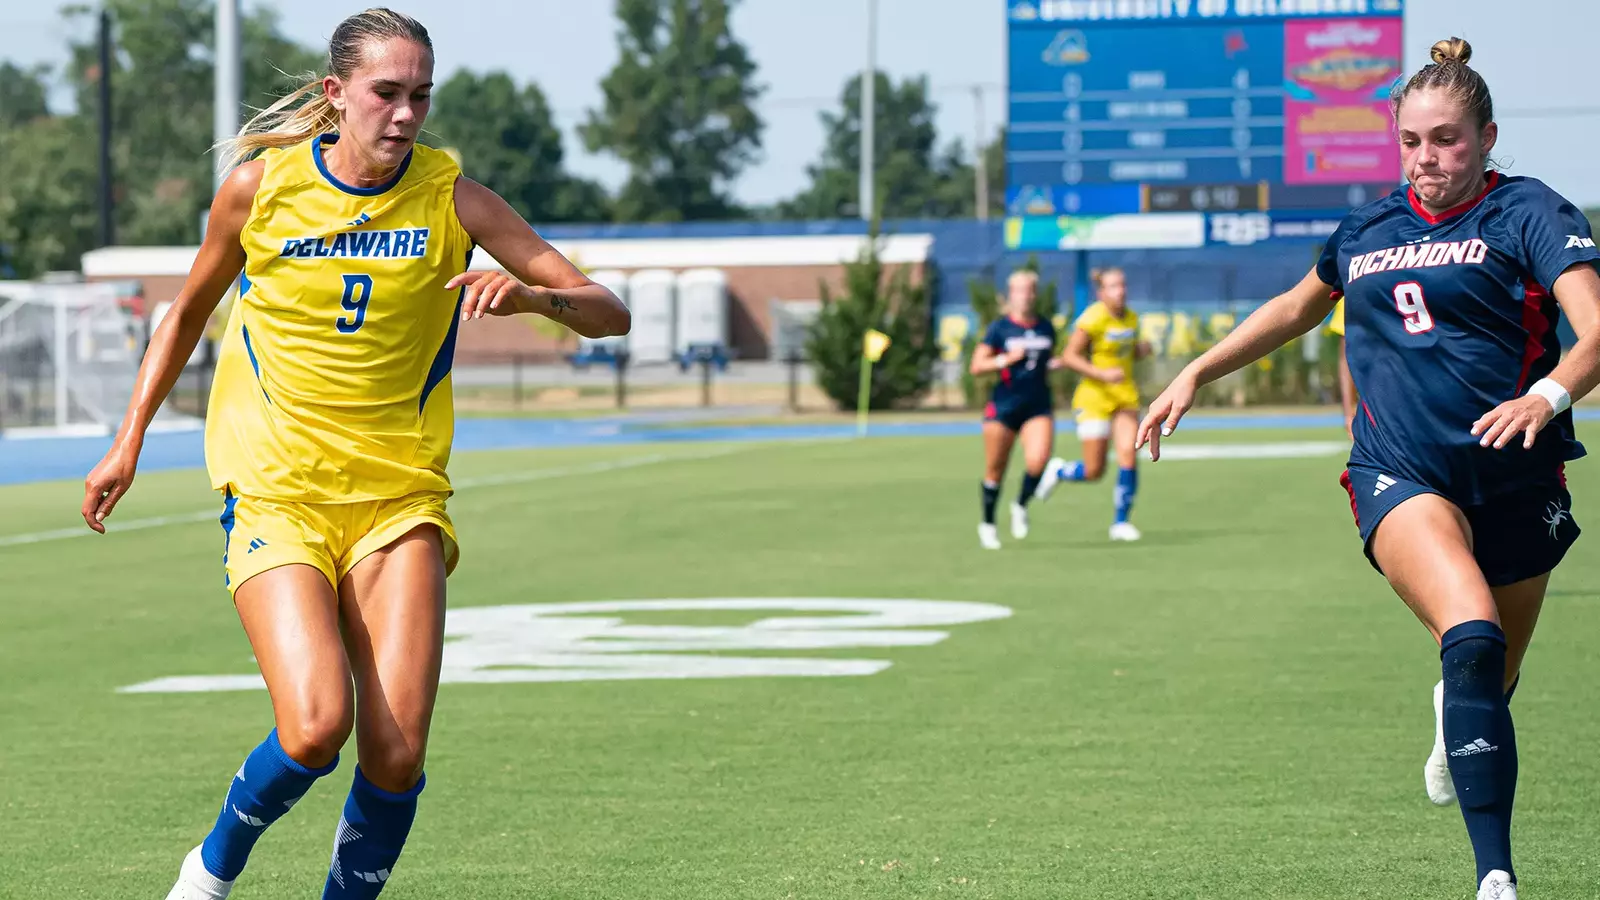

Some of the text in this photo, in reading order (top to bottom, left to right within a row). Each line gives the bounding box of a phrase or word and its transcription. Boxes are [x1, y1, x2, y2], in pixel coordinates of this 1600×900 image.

[279, 227, 430, 260] DELAWARE
[1348, 238, 1489, 283] RICHMOND
[335, 273, 374, 334] 9
[1393, 280, 1435, 335] 9
